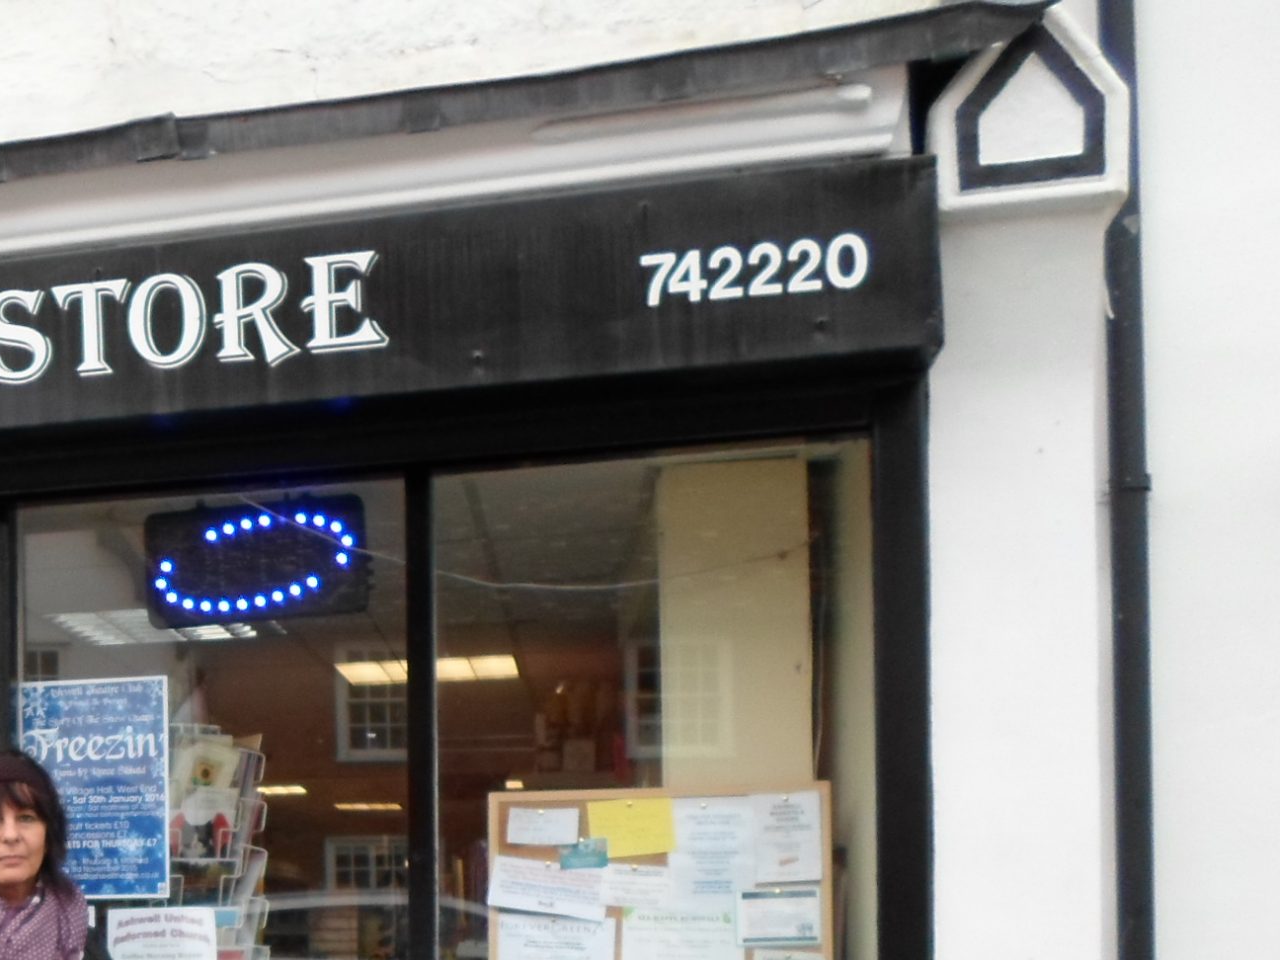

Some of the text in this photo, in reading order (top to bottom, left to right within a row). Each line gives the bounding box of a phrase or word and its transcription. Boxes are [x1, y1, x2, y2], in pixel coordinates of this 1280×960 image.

[639, 233, 868, 307] 742220
[73, 795, 87, 805] Sat
[108, 793, 143, 804] January
[68, 831, 115, 840] oncessions
[82, 839, 100, 849] FOR
[116, 913, 160, 930] Ashwell
